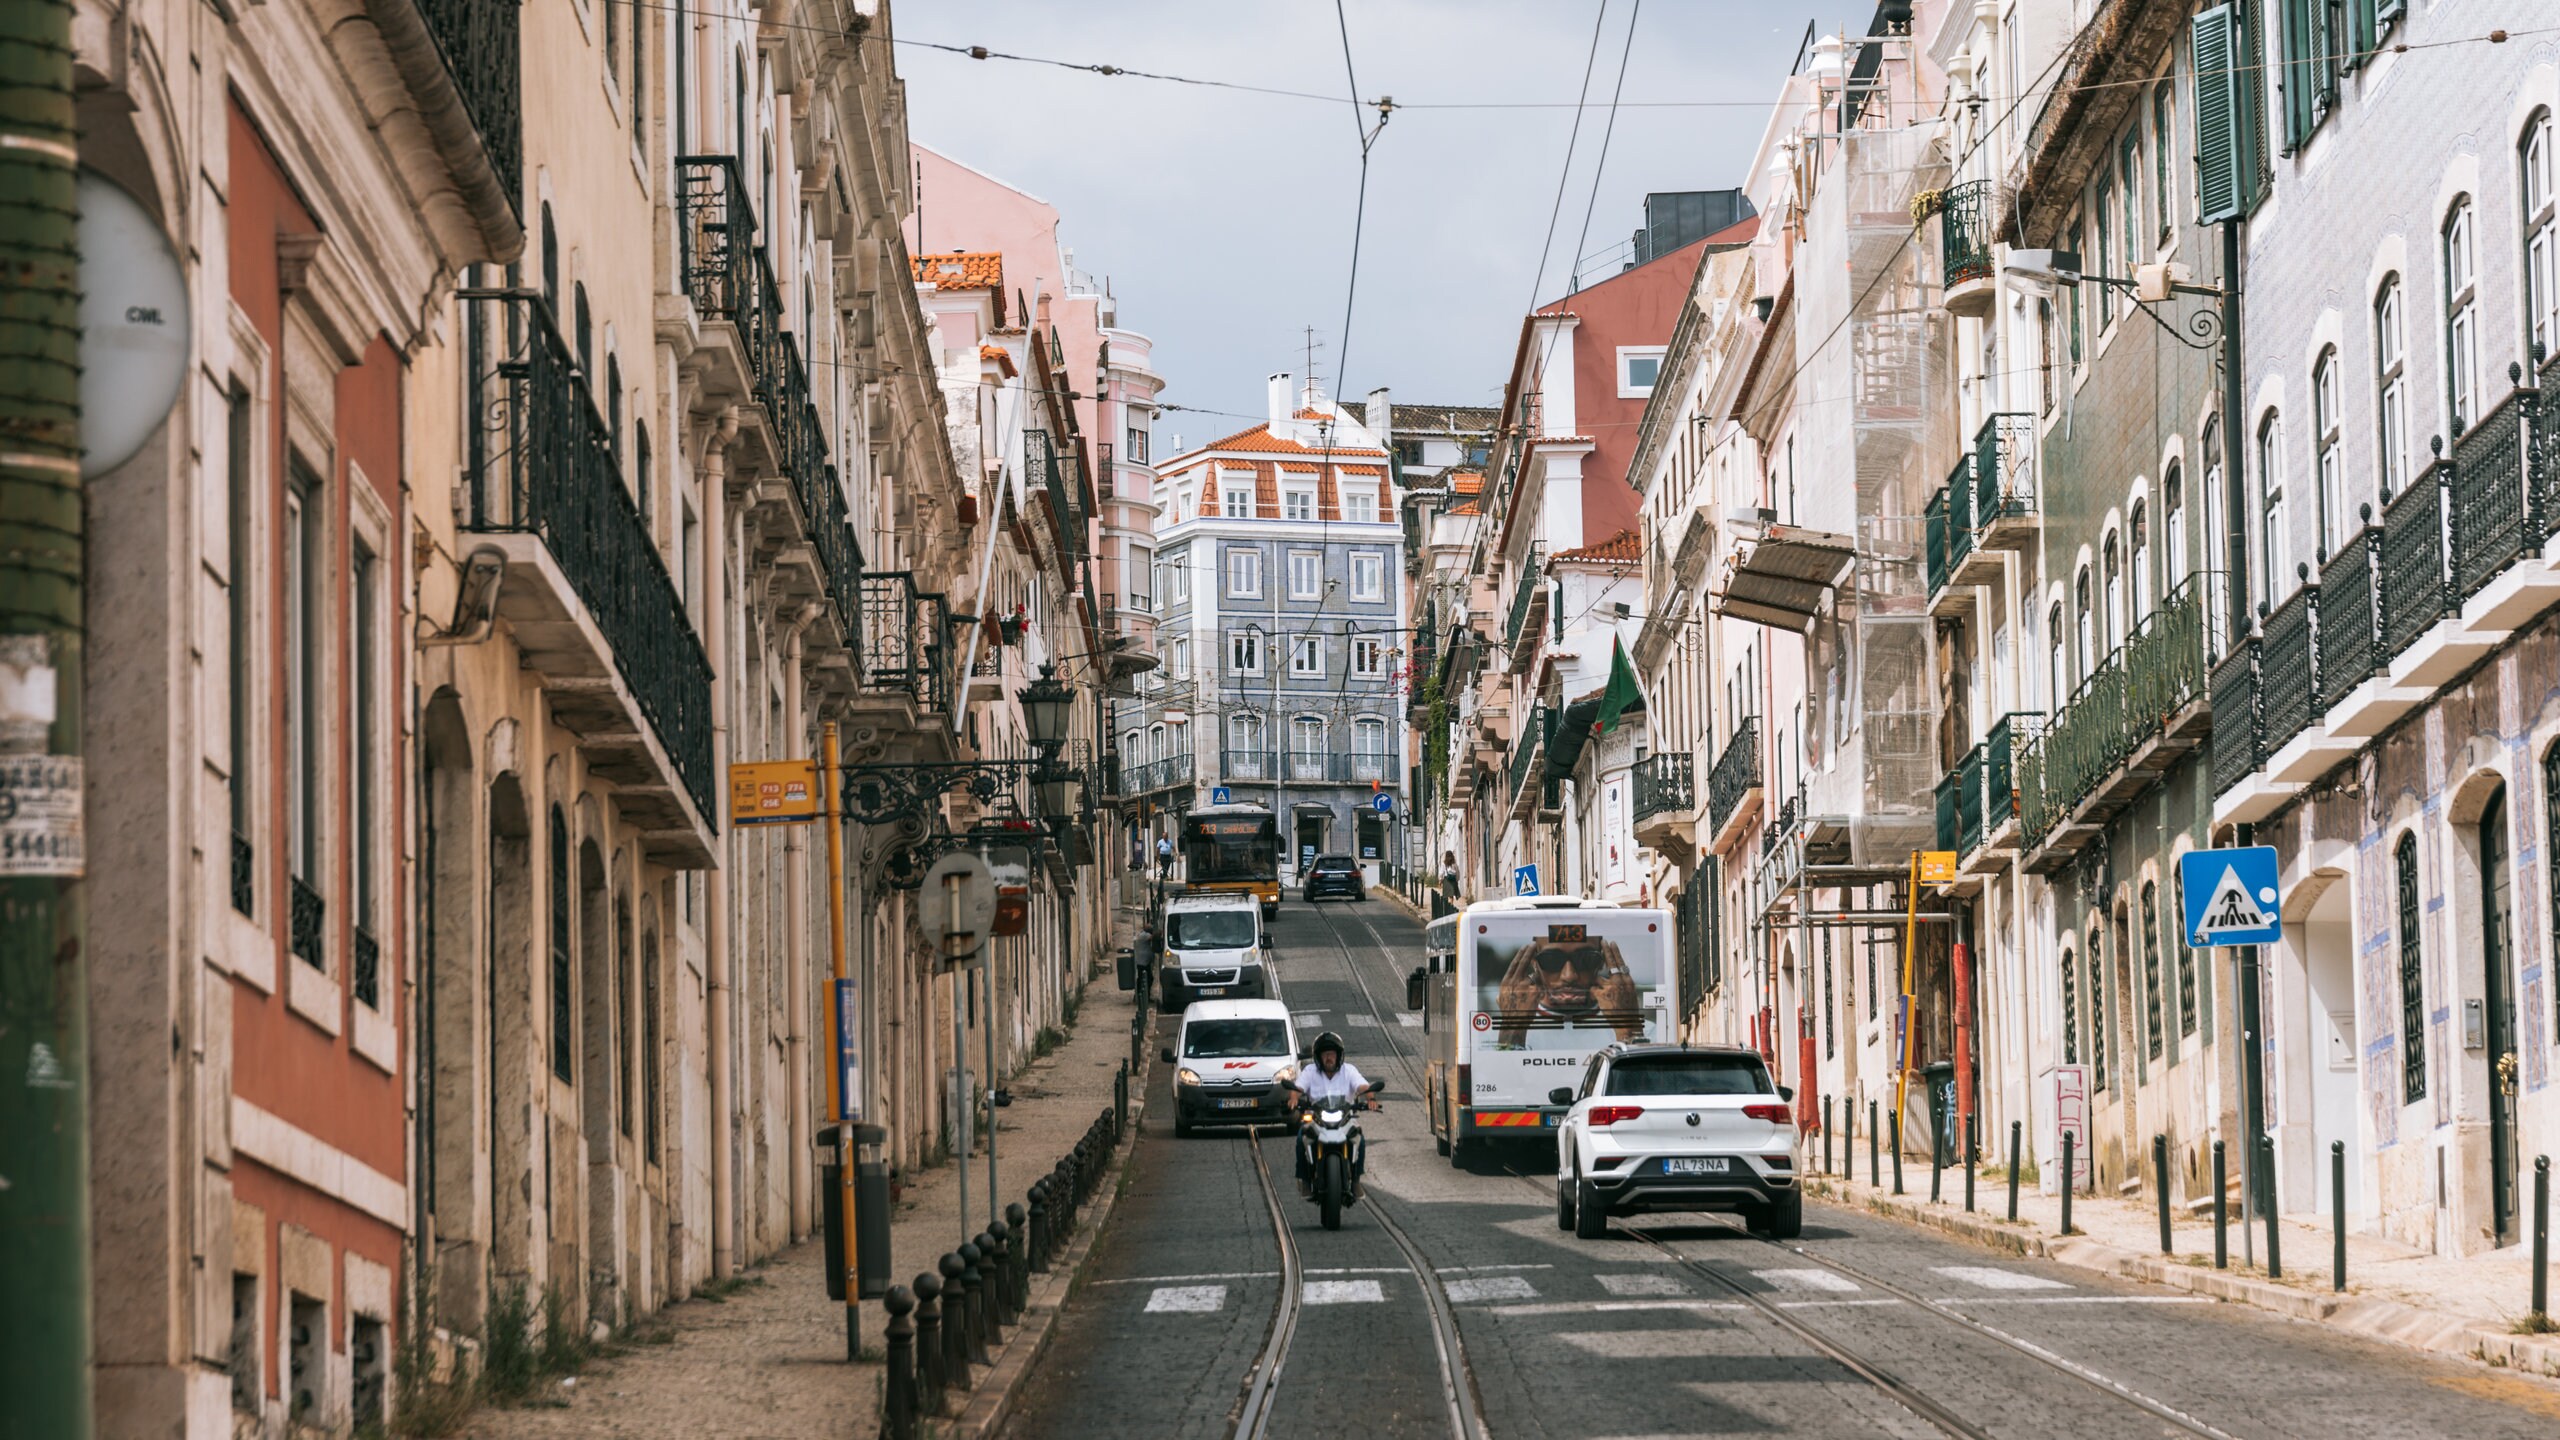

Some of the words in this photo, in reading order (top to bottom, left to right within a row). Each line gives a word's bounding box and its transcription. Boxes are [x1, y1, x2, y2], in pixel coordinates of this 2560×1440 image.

[1200, 823, 1217, 835] 713
[1553, 926, 1583, 941] 713
[1476, 1018, 1488, 1026] 80
[1523, 1058, 1577, 1066] POLICE
[1476, 1084, 1497, 1092] 2286
